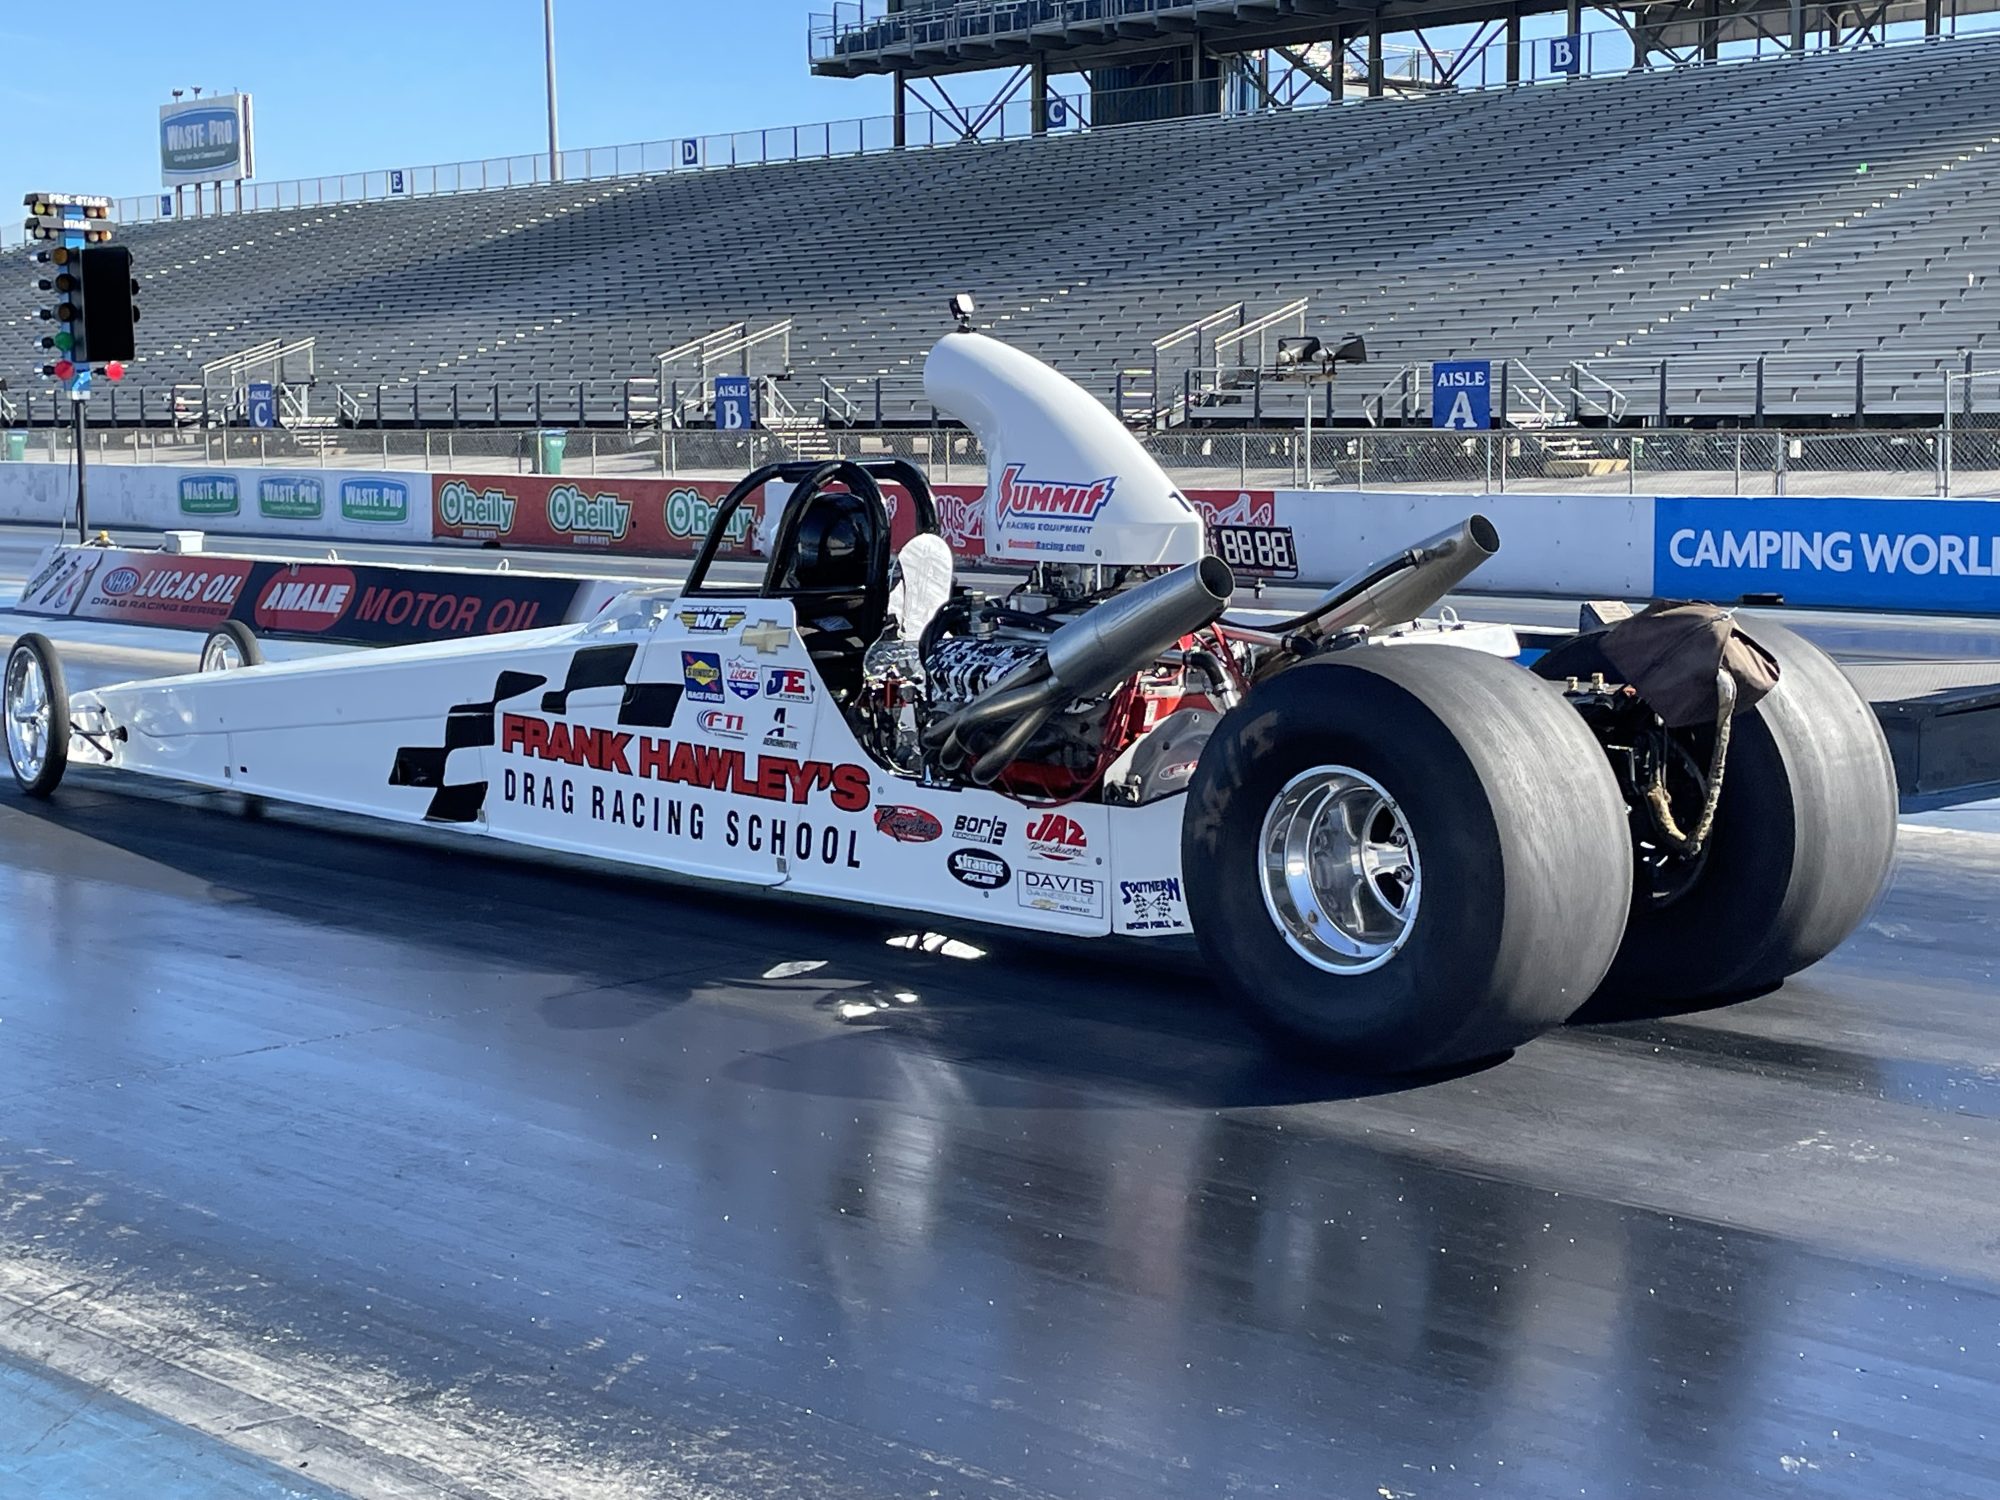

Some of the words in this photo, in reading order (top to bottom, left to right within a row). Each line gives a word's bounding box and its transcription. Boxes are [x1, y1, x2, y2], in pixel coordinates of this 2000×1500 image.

[1554, 41, 1573, 67] B
[1048, 101, 1064, 123] C
[167, 123, 205, 151] WASTE
[208, 119, 233, 146] PRO
[684, 142, 696, 161] D
[392, 173, 402, 190] E
[48, 193, 108, 208] PRE-STAGE
[718, 385, 748, 397] AISLE
[1437, 371, 1486, 387] AISLE
[254, 402, 268, 427] C
[724, 400, 742, 429] B
[1444, 390, 1478, 428] A
[182, 482, 213, 500] WASTE
[217, 482, 235, 500] PRO
[263, 483, 295, 504] WASTE
[299, 485, 318, 504] PRO
[345, 486, 379, 507] WASTE
[383, 488, 403, 508] PRO
[441, 484, 516, 533] O'Reilly
[550, 487, 630, 537] O'Reilly
[1006, 521, 1036, 531] RACING
[1038, 523, 1093, 534] EQUIPMENT
[1669, 529, 1853, 572] CAMPING
[106, 571, 137, 591] NHRA
[134, 570, 208, 601] LUCAS
[202, 574, 242, 604] OIL
[91, 597, 127, 608] DRAG
[128, 601, 179, 612] RACING
[180, 604, 229, 616] SERIES
[261, 583, 351, 613] AMALIE
[355, 587, 482, 633] MOTOR
[486, 599, 540, 633] OIL
[695, 613, 731, 629] M/T
[730, 669, 757, 681] LUCAS
[766, 670, 805, 695] JE
[707, 711, 744, 731] FTI
[502, 712, 635, 776] FRANK
[638, 736, 871, 813] HAWLEY'S
[504, 768, 574, 814] DRAG
[591, 785, 705, 840] RACING
[726, 810, 861, 868] SCHOOL
[1026, 813, 1087, 847] JAZ
[954, 853, 1004, 877] Strange
[1025, 872, 1095, 895] DAVIS
[1120, 877, 1182, 905] SOUTHERN
